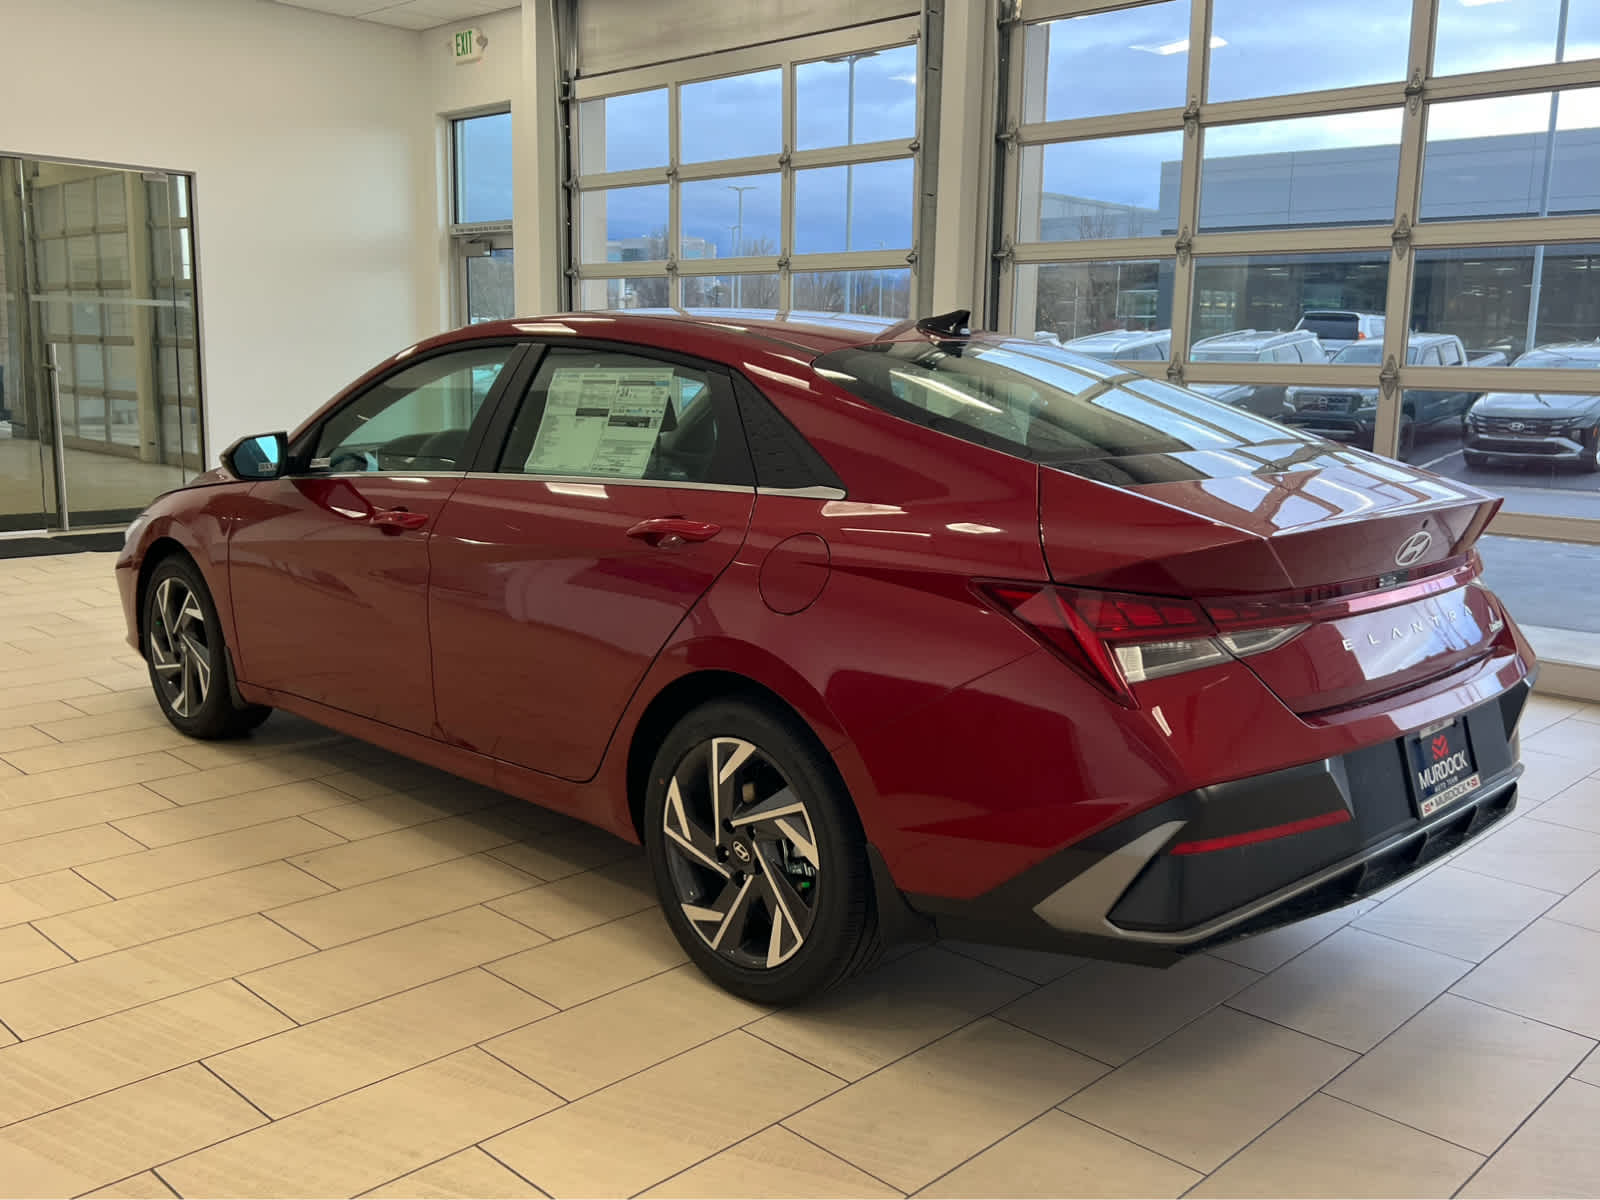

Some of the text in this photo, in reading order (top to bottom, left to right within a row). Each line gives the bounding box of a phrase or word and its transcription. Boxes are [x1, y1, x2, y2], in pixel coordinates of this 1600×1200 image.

[455, 31, 473, 57] EXIT
[1342, 605, 1473, 651] ELANTRA
[1418, 750, 1468, 790] MURDOCK
